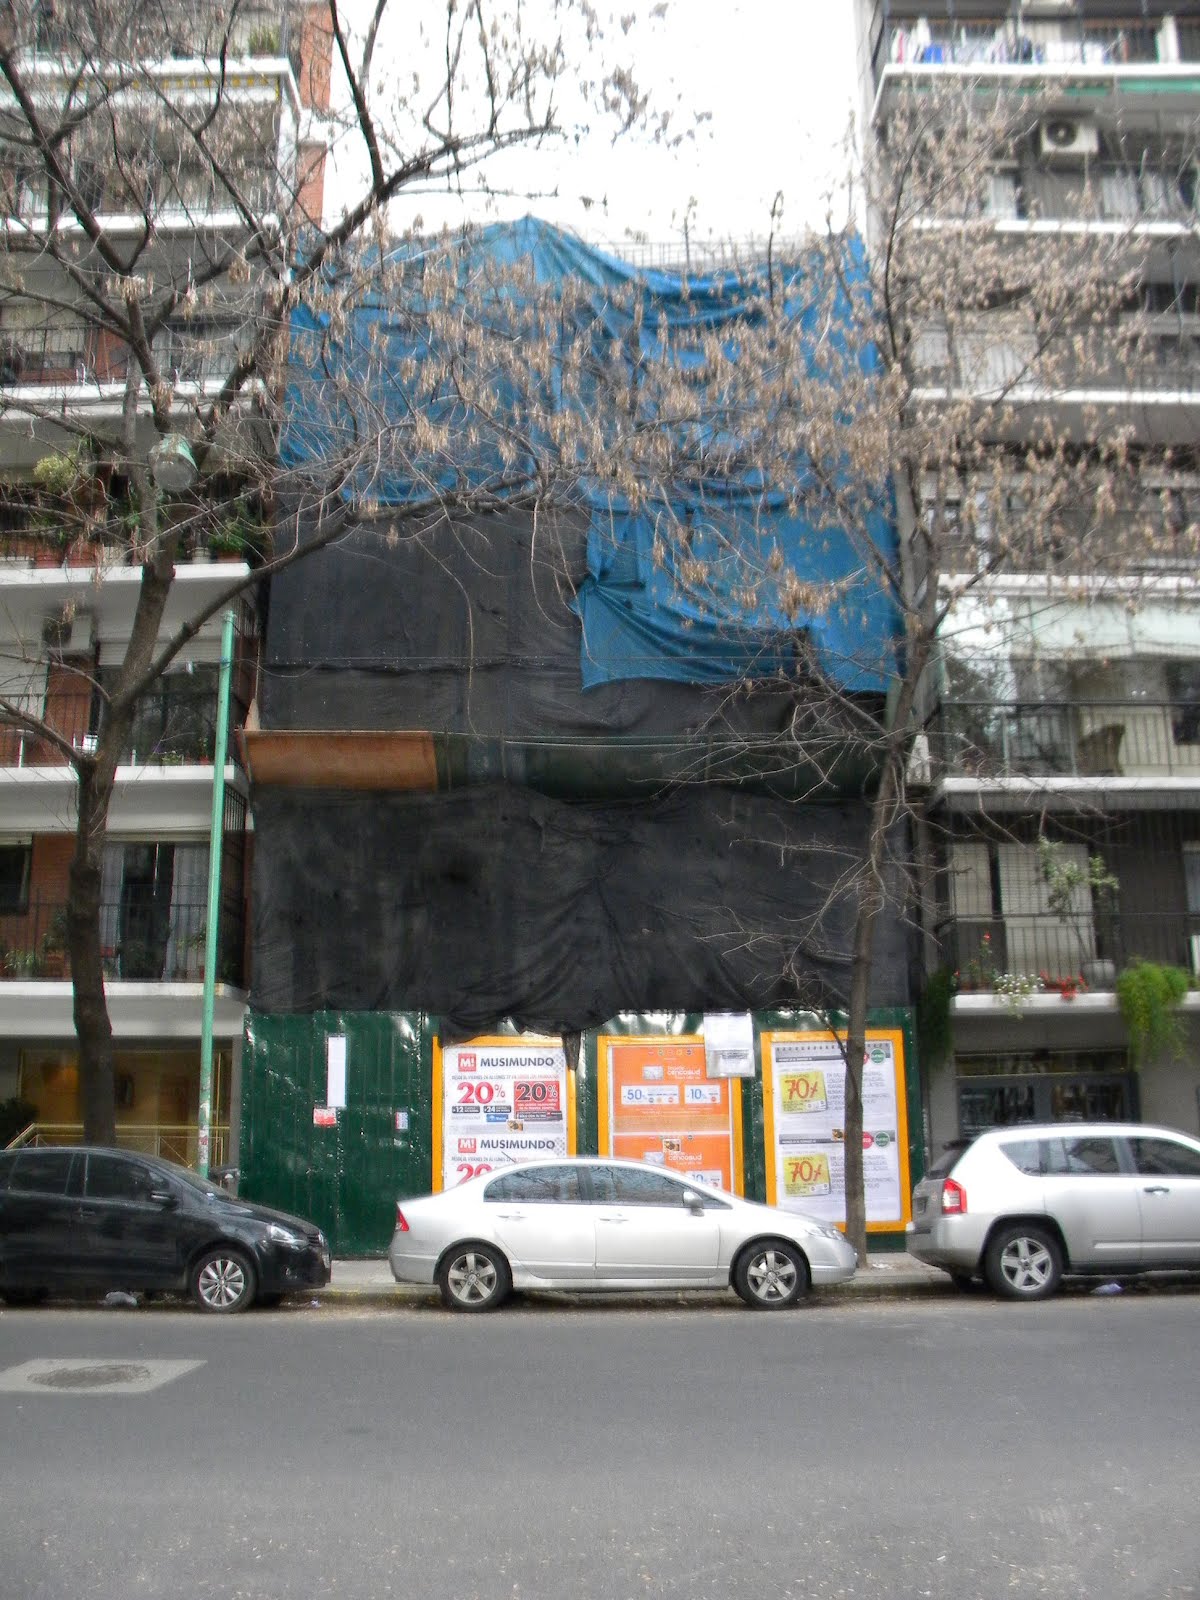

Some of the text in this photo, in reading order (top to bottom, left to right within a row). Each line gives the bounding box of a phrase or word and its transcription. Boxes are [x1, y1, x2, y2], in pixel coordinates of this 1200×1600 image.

[480, 1057, 554, 1067] MUSIMUNDO
[457, 1081, 506, 1104] 20%
[516, 1082, 558, 1102] 20%
[480, 1139, 555, 1149] MUSIMUNDO
